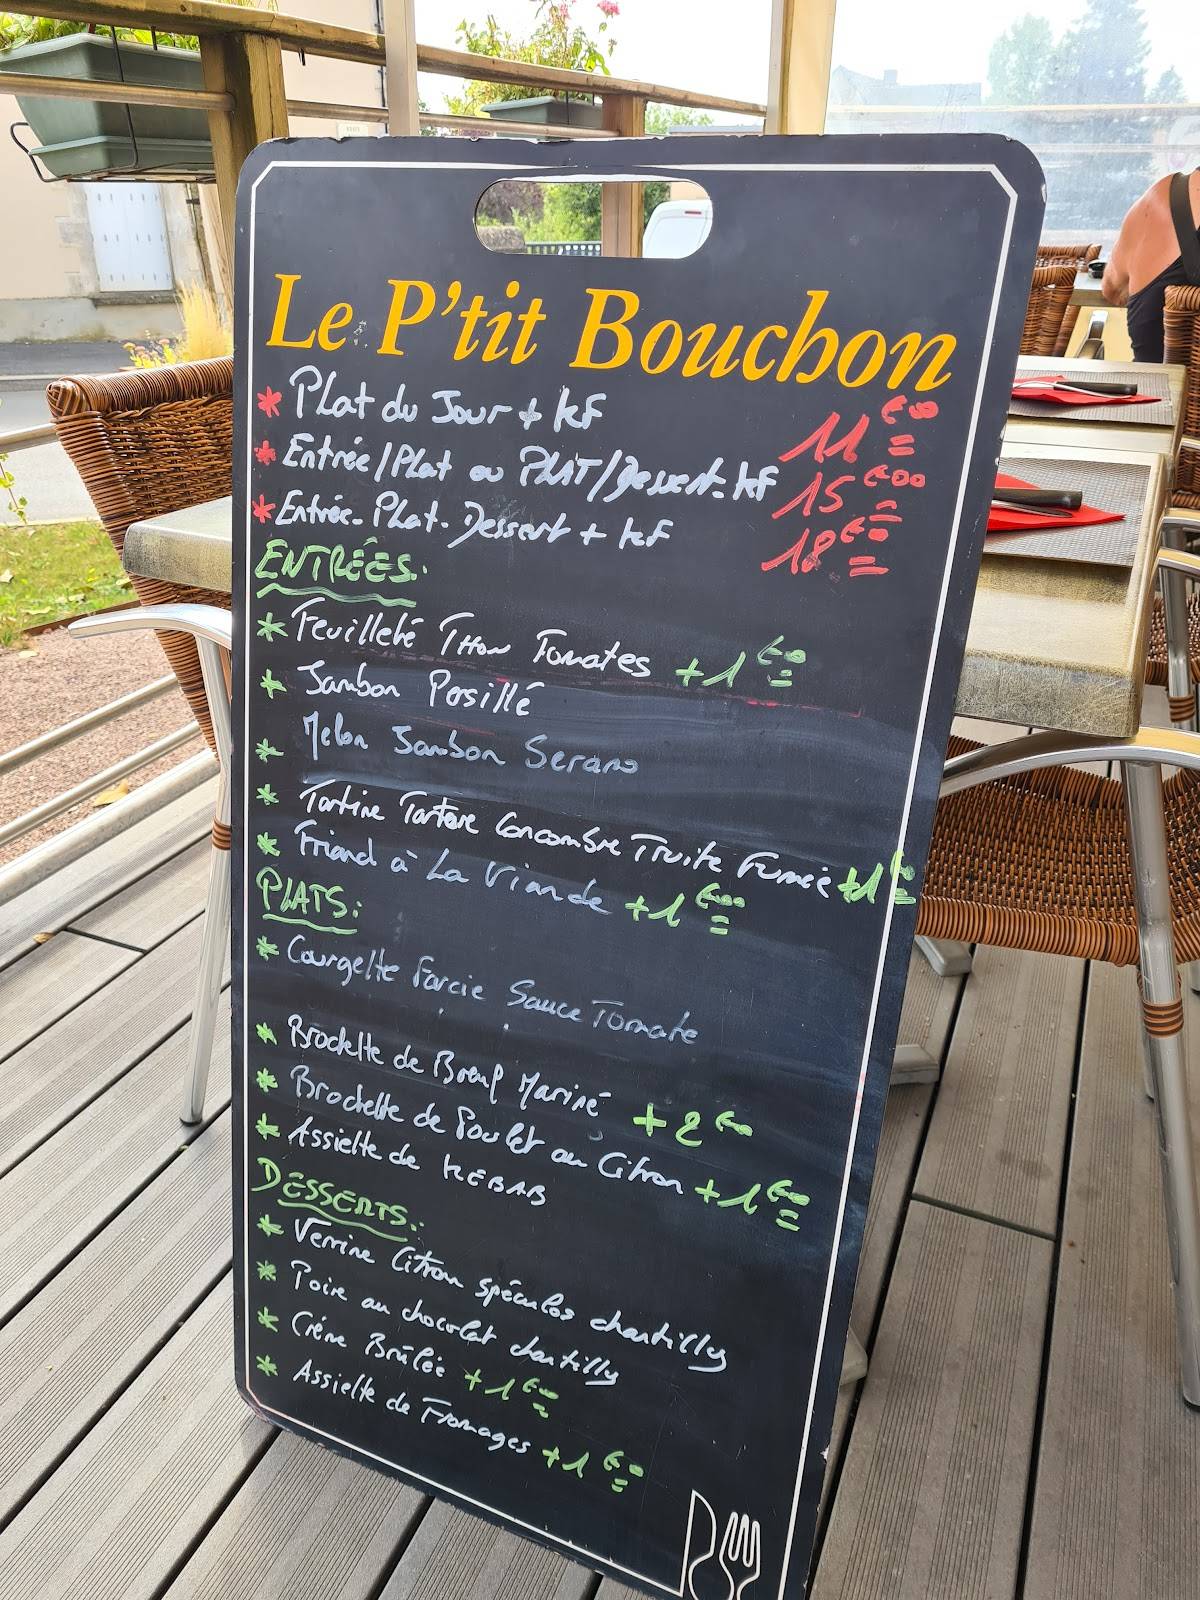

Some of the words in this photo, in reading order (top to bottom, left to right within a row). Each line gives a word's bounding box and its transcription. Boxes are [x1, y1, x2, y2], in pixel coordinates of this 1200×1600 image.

[266, 273, 354, 351] Le
[377, 279, 547, 365] P'tit
[568, 288, 957, 392] Bouchon
[381, 384, 418, 423] du
[431, 390, 513, 425] Jour
[448, 501, 571, 548] Dessert
[297, 660, 401, 698] Jambon
[533, 628, 652, 678] Tomates
[302, 711, 369, 761] Melon
[391, 725, 506, 765] Jambon
[294, 819, 378, 867] Friand
[391, 850, 418, 873] à
[484, 860, 613, 915] Viande
[300, 778, 386, 821] Tartine
[631, 833, 722, 873] Truite
[287, 934, 401, 987] Courgette
[412, 956, 487, 1000] Farcie
[507, 979, 584, 1023] Sauce
[592, 1000, 700, 1045] Tomate
[287, 1013, 385, 1065] Brochette
[393, 1044, 425, 1074] de
[288, 1116, 383, 1160] Assiette
[388, 1143, 421, 1170] de
[290, 1064, 405, 1122] Brochette
[413, 1102, 446, 1133] de
[457, 1105, 546, 1155] Poulet
[551, 1148, 588, 1168] au
[598, 1152, 684, 1195] Citron
[291, 1260, 348, 1301] Poire
[361, 1297, 391, 1315] au
[402, 1299, 497, 1345] chocolat
[509, 1336, 620, 1386] chantilly
[294, 1217, 376, 1264] Verrine
[392, 1246, 465, 1288] Citron
[590, 1310, 727, 1373] chantilly
[293, 1359, 375, 1403] Assiette
[386, 1392, 411, 1415] de
[422, 1397, 532, 1454] Fromages
